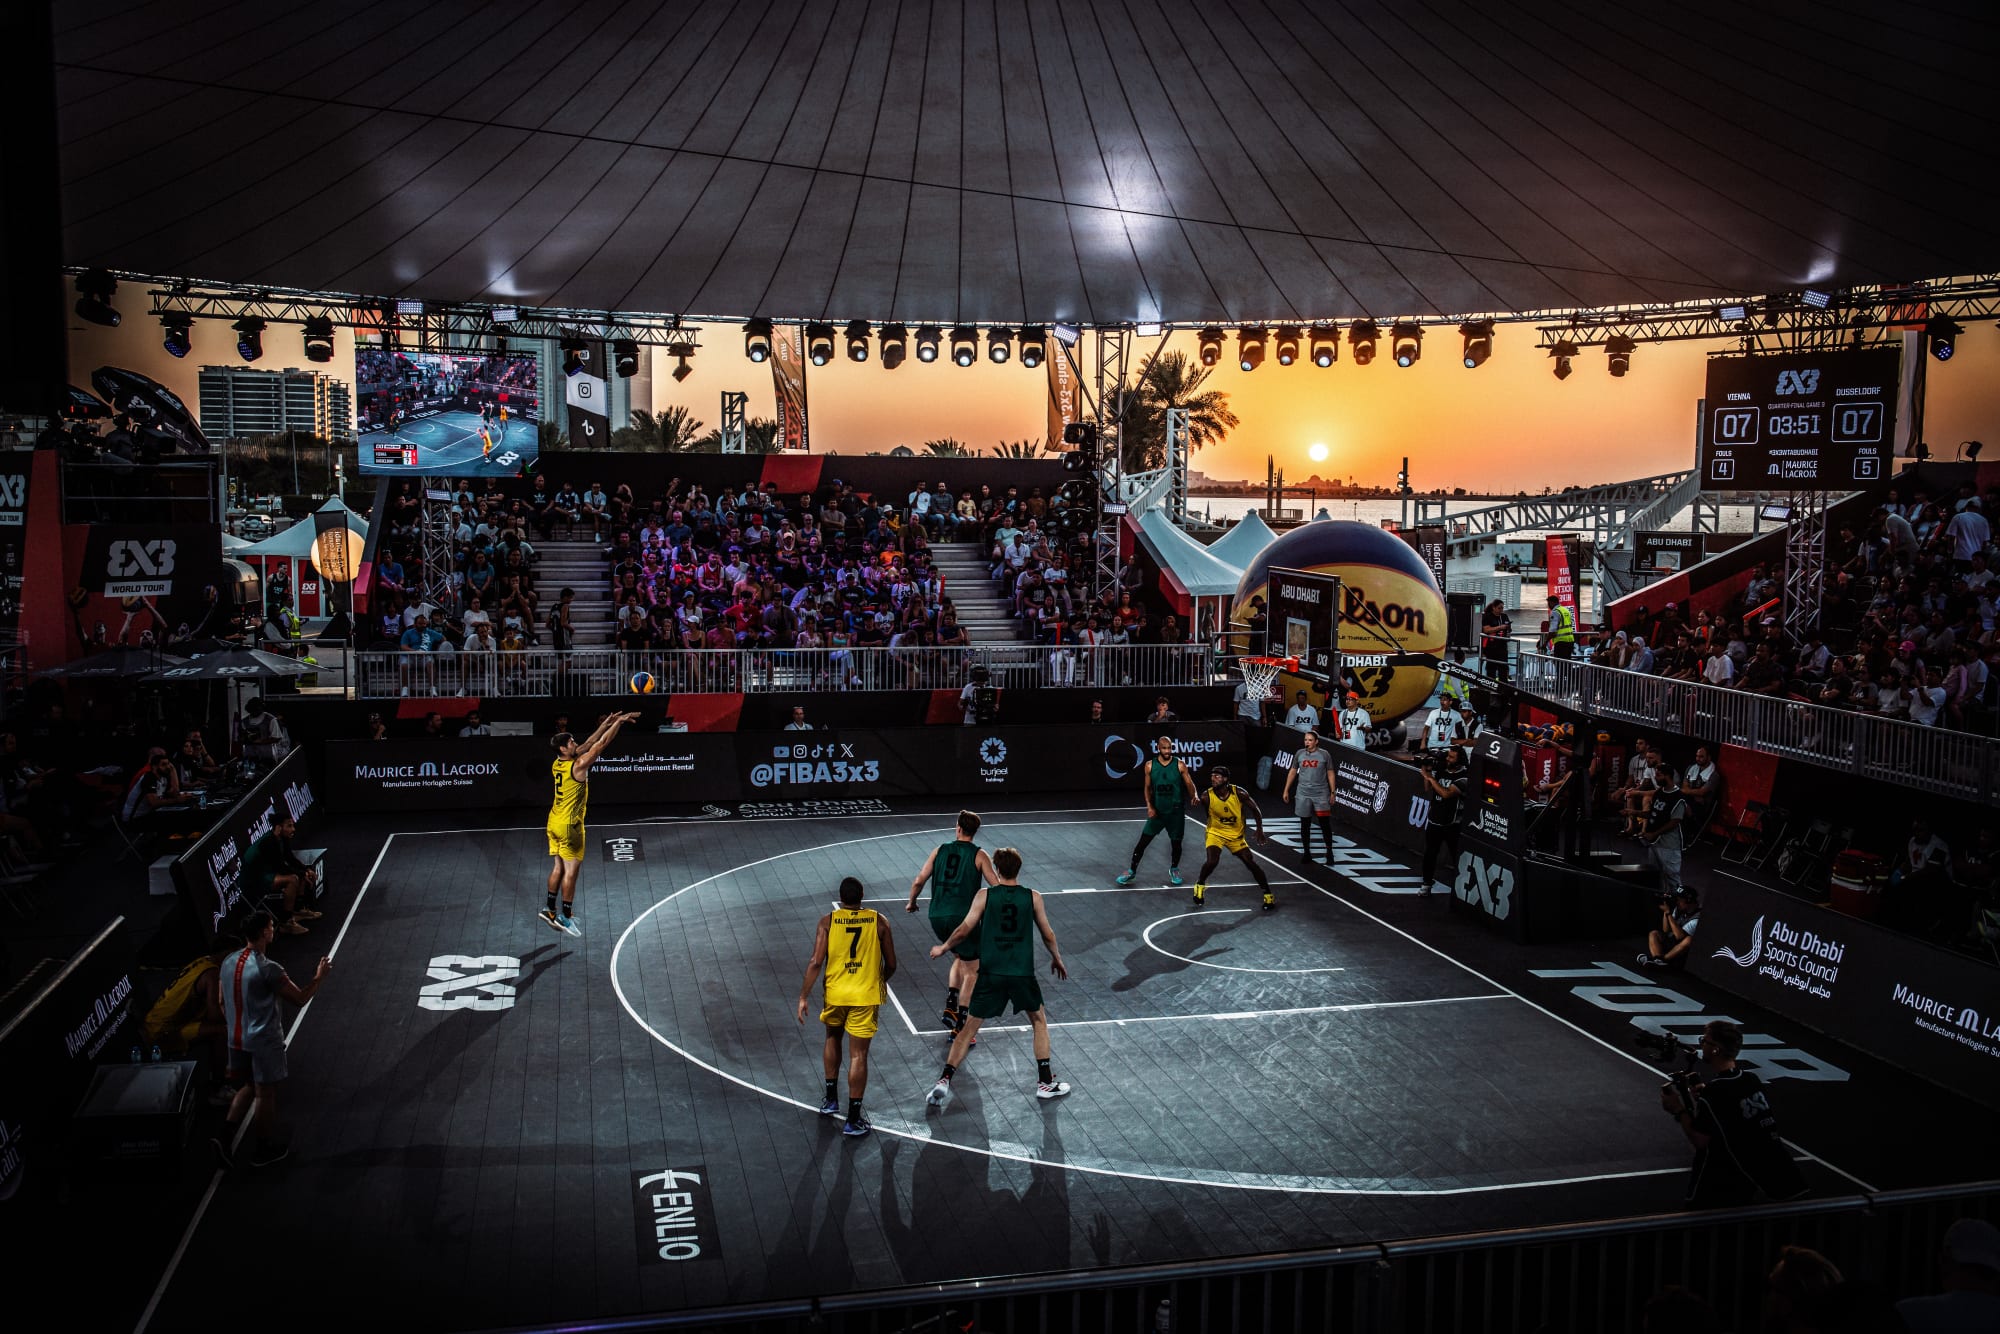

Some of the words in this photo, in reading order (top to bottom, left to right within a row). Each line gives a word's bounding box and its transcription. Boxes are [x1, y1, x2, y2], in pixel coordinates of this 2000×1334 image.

[1727, 393, 1751, 401] VIENNA
[1722, 413, 1752, 438] 07
[1769, 414, 1821, 436] 03:51
[1841, 409, 1874, 436] 07
[1858, 447, 1877, 455] FOULS
[1718, 462, 1727, 476] 4
[1785, 460, 1818, 469] MAURICE
[1861, 460, 1872, 476] 5
[1785, 469, 1817, 479] LACROIX
[0, 474, 27, 508] X3
[1646, 538, 1663, 546] ABU
[1665, 538, 1693, 546] DHABI
[112, 585, 141, 593] WORLD
[143, 584, 165, 592] TOUR
[1281, 584, 1295, 599] ABU
[1296, 586, 1321, 604] DHABI
[1346, 656, 1388, 668] DHABI
[1150, 739, 1222, 753] tdweer
[591, 765, 599, 773] Al
[633, 765, 671, 773] Equipment
[672, 763, 695, 772] Rental
[1274, 750, 1293, 769] ABU
[355, 765, 414, 780] MAURICE
[441, 762, 500, 777] LACROIX
[751, 760, 880, 788] @FIBA3x3
[980, 767, 1008, 777] burjeel
[382, 780, 421, 789] Manufacture
[422, 779, 452, 788] Horlogère
[453, 778, 473, 786] Suisse
[555, 773, 563, 796] 2
[738, 801, 793, 809] Abu
[803, 799, 883, 808] Dhabi
[944, 853, 961, 879] 9
[1001, 903, 1018, 932] 3
[845, 926, 862, 959] 7
[1769, 920, 1799, 947] Abu
[1800, 931, 1845, 964] Dhabi
[1763, 941, 1799, 968] Sports
[1798, 954, 1839, 983] Council
[1759, 964, 1785, 981] الرياضي
[1783, 974, 1811, 991] أبوظبي
[1809, 983, 1831, 999] مجلس
[1892, 983, 1956, 1023] MAURICE
[64, 1012, 99, 1059] MAURICE
[103, 974, 134, 1014] LACROIX
[1527, 961, 1851, 1083] TOUR
[1914, 1016, 1956, 1040] Manufacture
[1956, 1033, 1990, 1053] Horlogère
[652, 1192, 701, 1261] ENLIO
